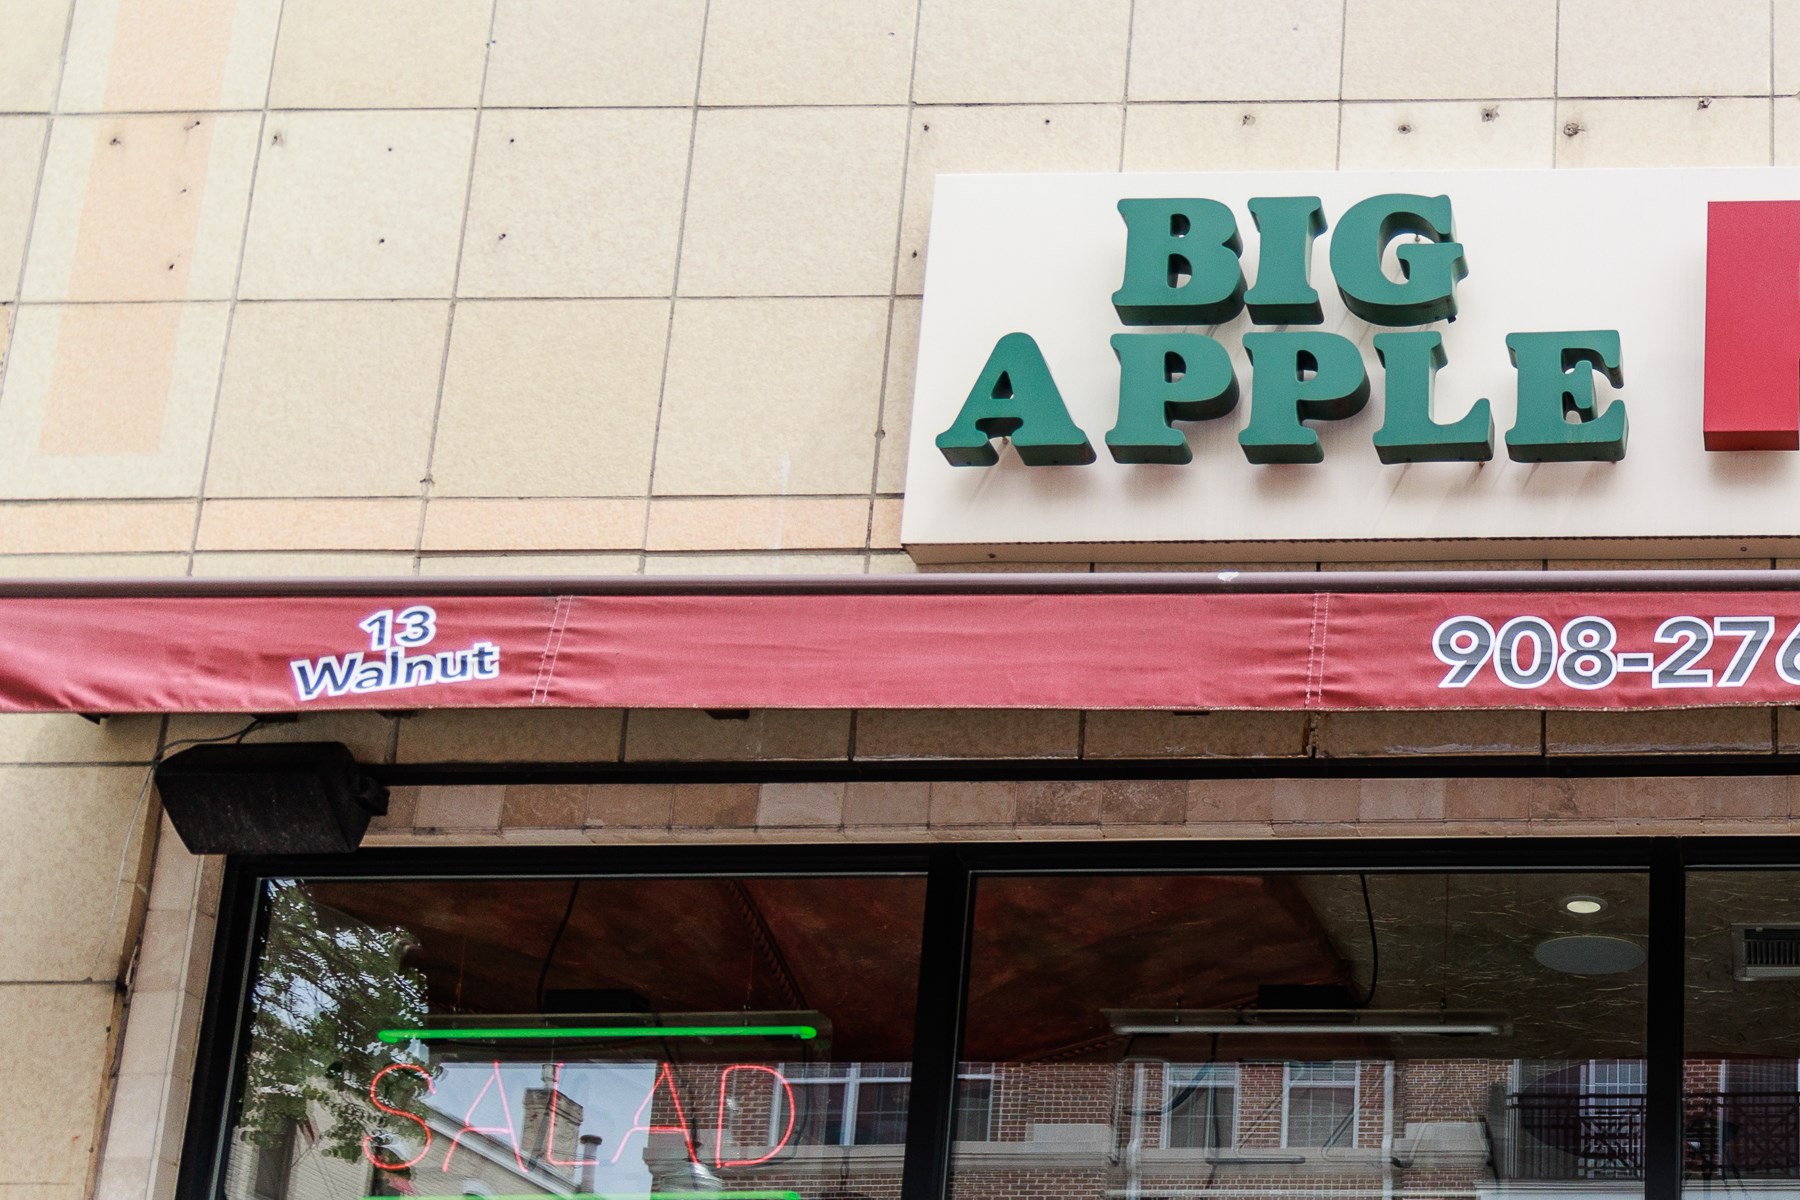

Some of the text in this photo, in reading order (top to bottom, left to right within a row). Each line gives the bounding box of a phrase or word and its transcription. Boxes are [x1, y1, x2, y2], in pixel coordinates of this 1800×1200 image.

[1111, 192, 1469, 327] BIG
[935, 330, 1628, 467] APPLE
[291, 642, 500, 701] Walnut
[360, 605, 437, 654] 13
[362, 1061, 796, 1173] SALAD
